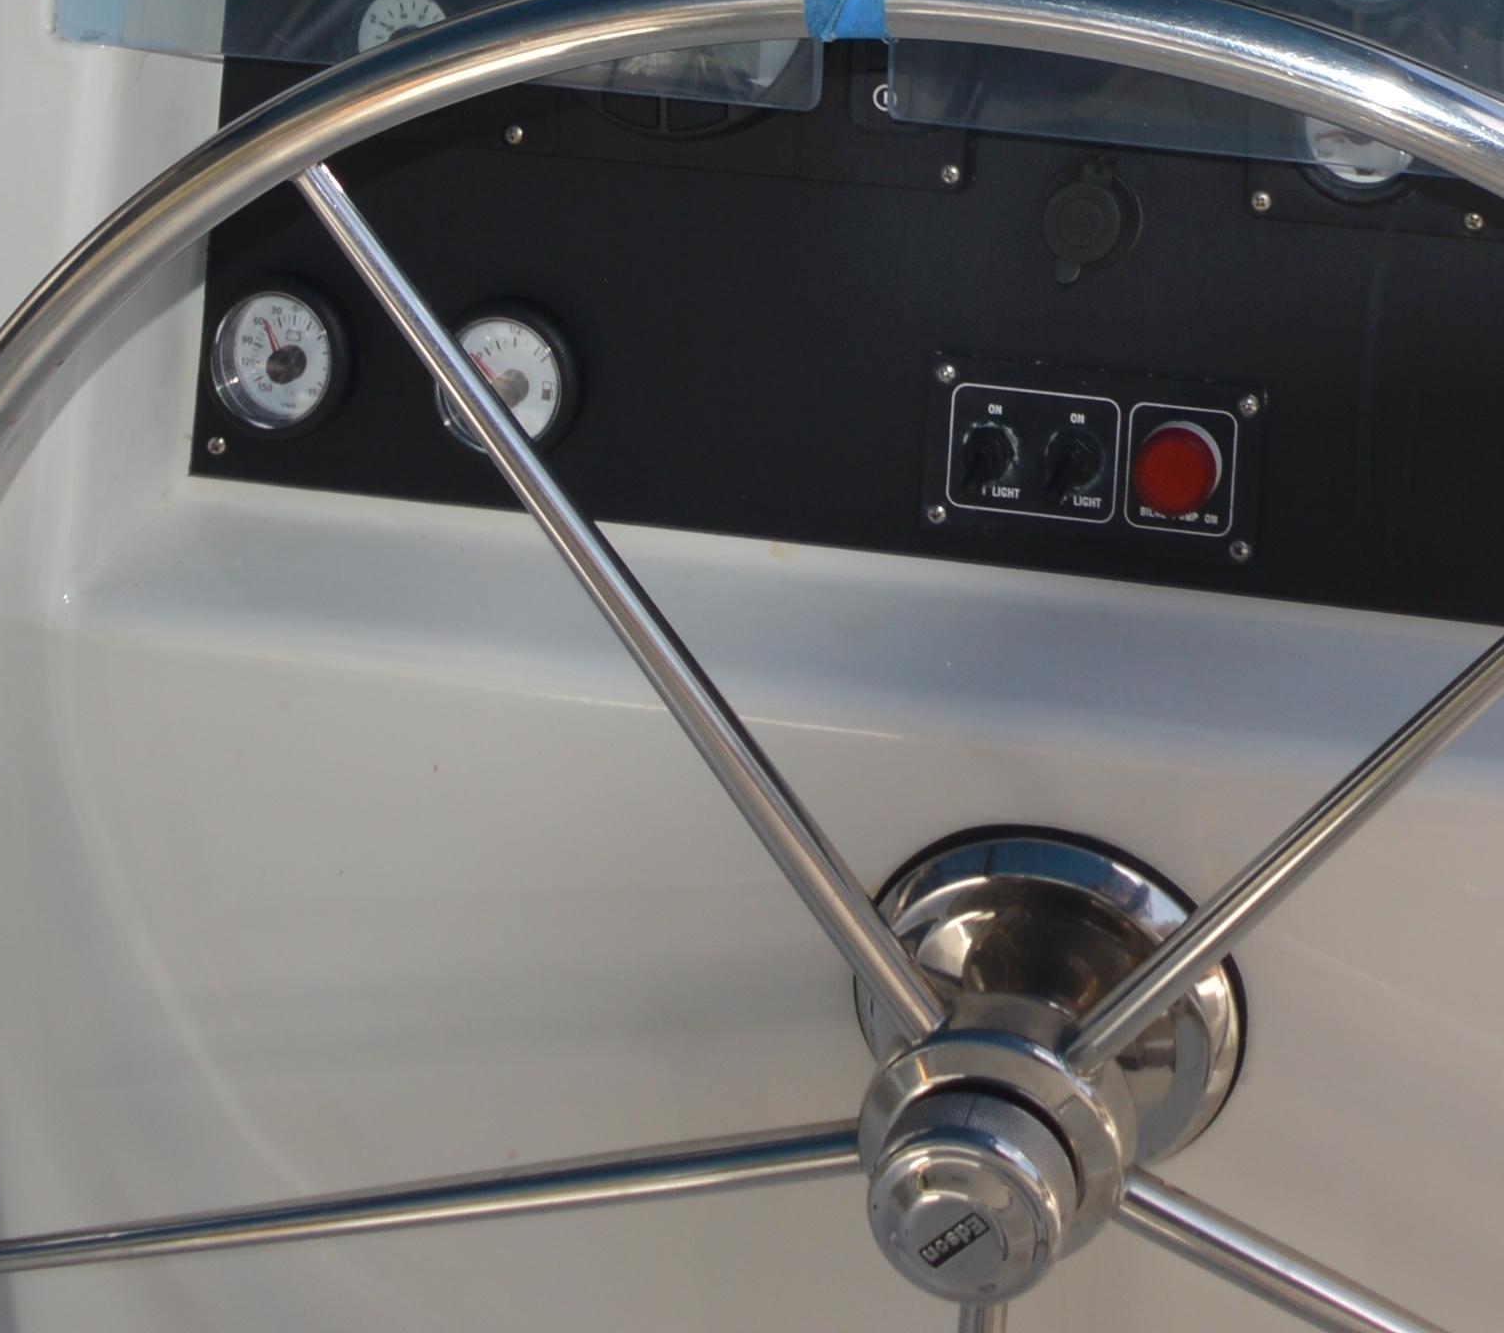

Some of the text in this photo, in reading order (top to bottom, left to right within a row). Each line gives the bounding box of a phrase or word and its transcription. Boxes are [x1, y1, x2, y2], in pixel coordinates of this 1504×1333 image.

[272, 305, 283, 315] 30
[241, 334, 254, 345] 90
[987, 403, 1003, 415] ON
[1069, 413, 1085, 425] ON
[991, 486, 1021, 500] LIGHT
[1072, 495, 1103, 509] LIGHT
[1203, 513, 1219, 525] ON
[921, 1213, 988, 1263] Edson
